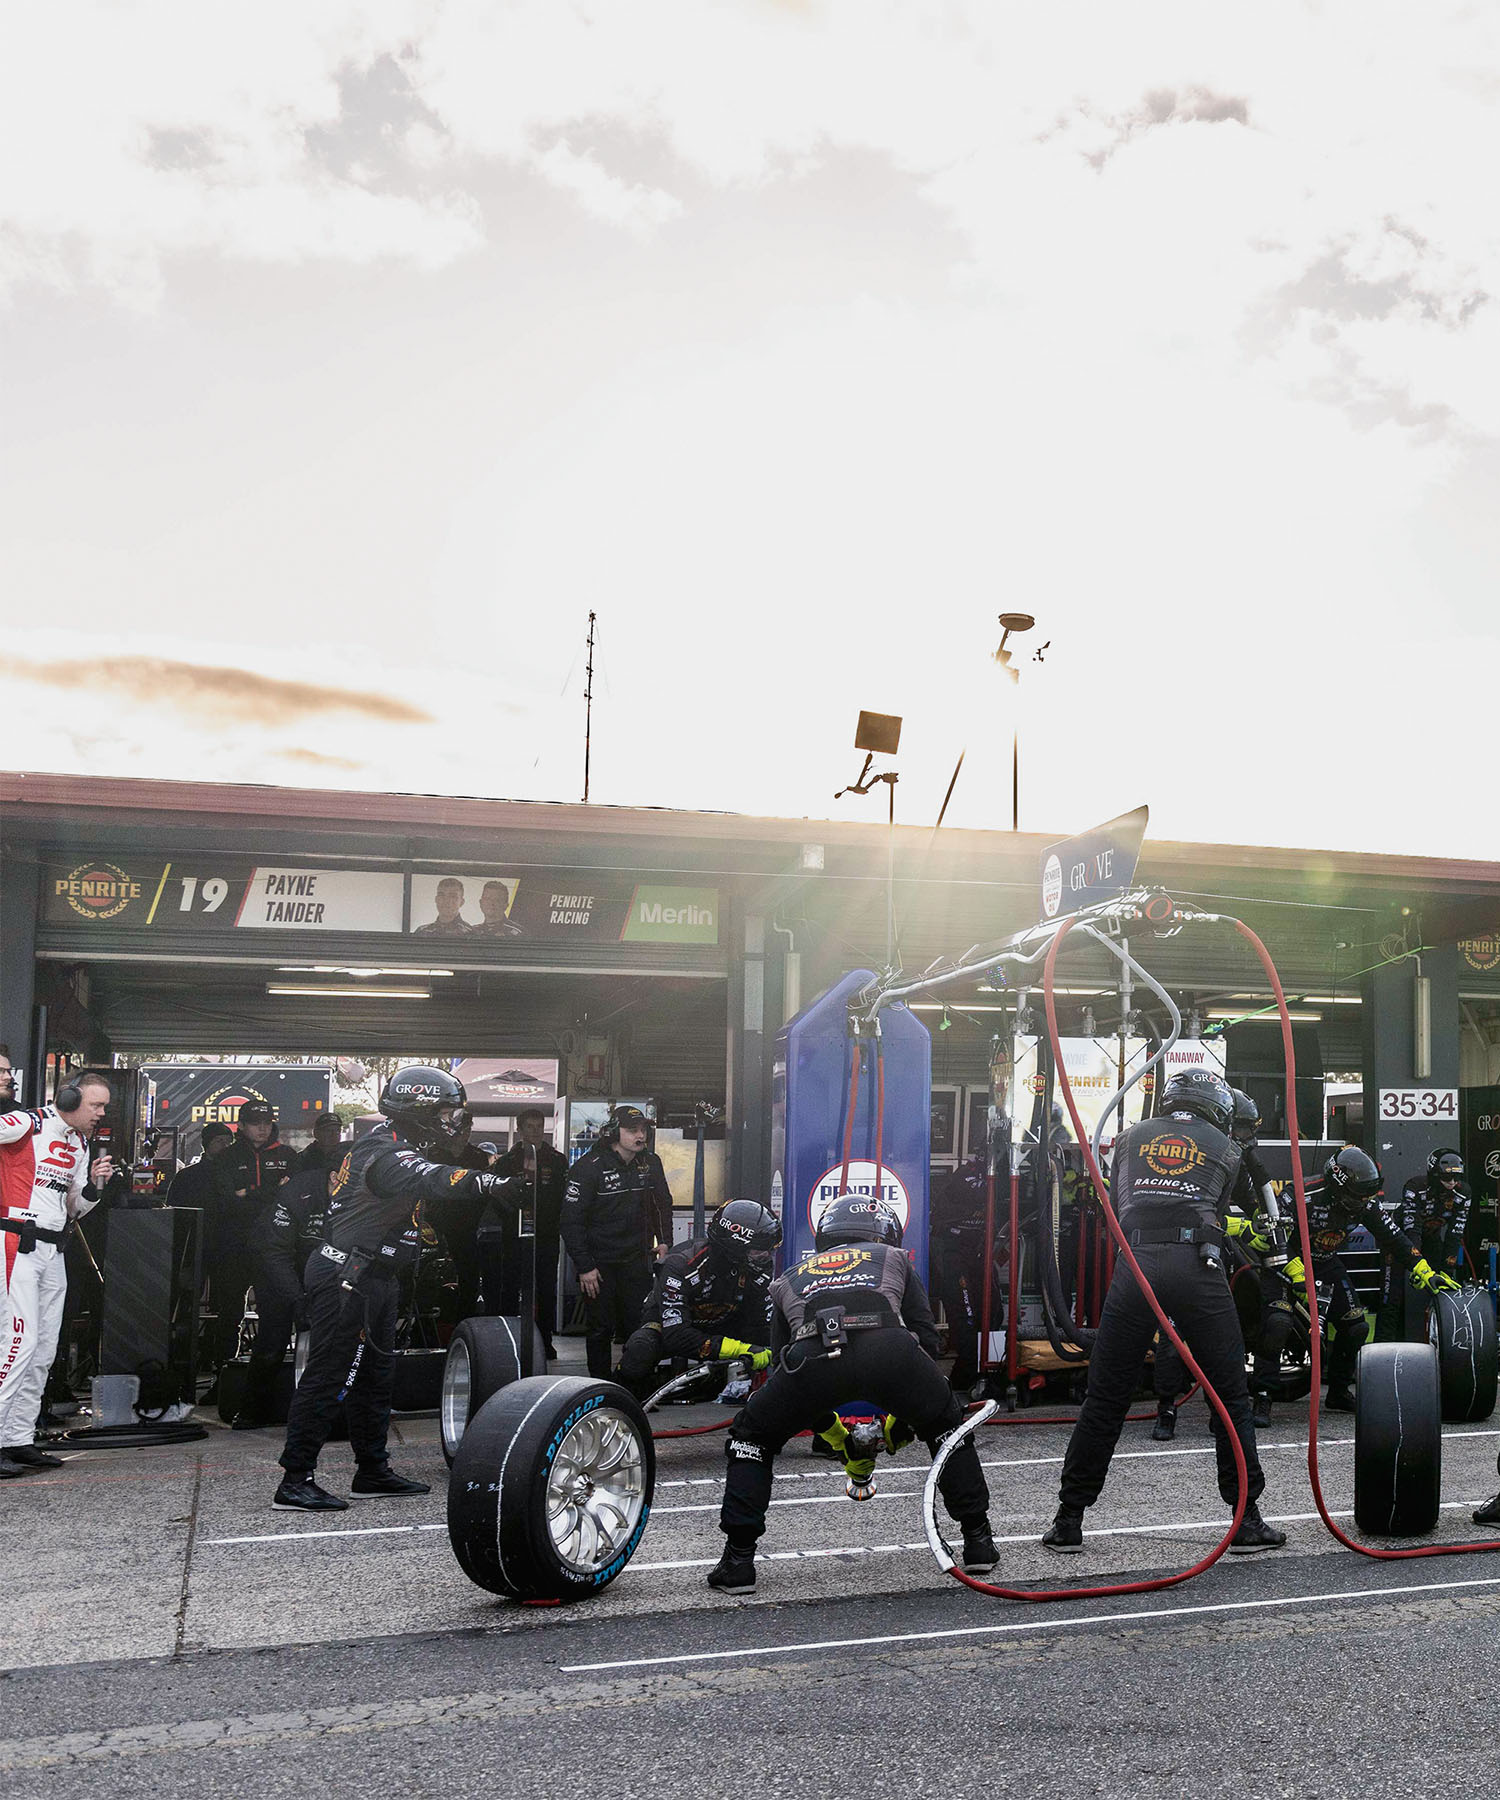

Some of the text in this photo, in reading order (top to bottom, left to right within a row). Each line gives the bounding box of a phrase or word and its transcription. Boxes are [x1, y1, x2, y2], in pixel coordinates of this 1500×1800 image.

[55, 880, 142, 899] PENRITE
[179, 877, 229, 912] 19
[264, 874, 318, 897] PAYNE
[264, 901, 326, 923] TANDER
[550, 894, 595, 910] PENRITE
[550, 910, 590, 925] RACING
[639, 902, 714, 926] Merlin
[1165, 1052, 1205, 1063] TANAWAY
[395, 1084, 441, 1094] GROVE
[1383, 1092, 1456, 1117] 35 34
[1139, 1143, 1207, 1166] PENRITE
[1134, 1178, 1181, 1187] RACING
[719, 1217, 754, 1239] GROVE
[798, 1250, 872, 1275] PENRITE
[802, 1274, 851, 1294] RACING
[345, 1343, 366, 1387] SINCE 1926
[546, 1394, 606, 1463] DUNLOP
